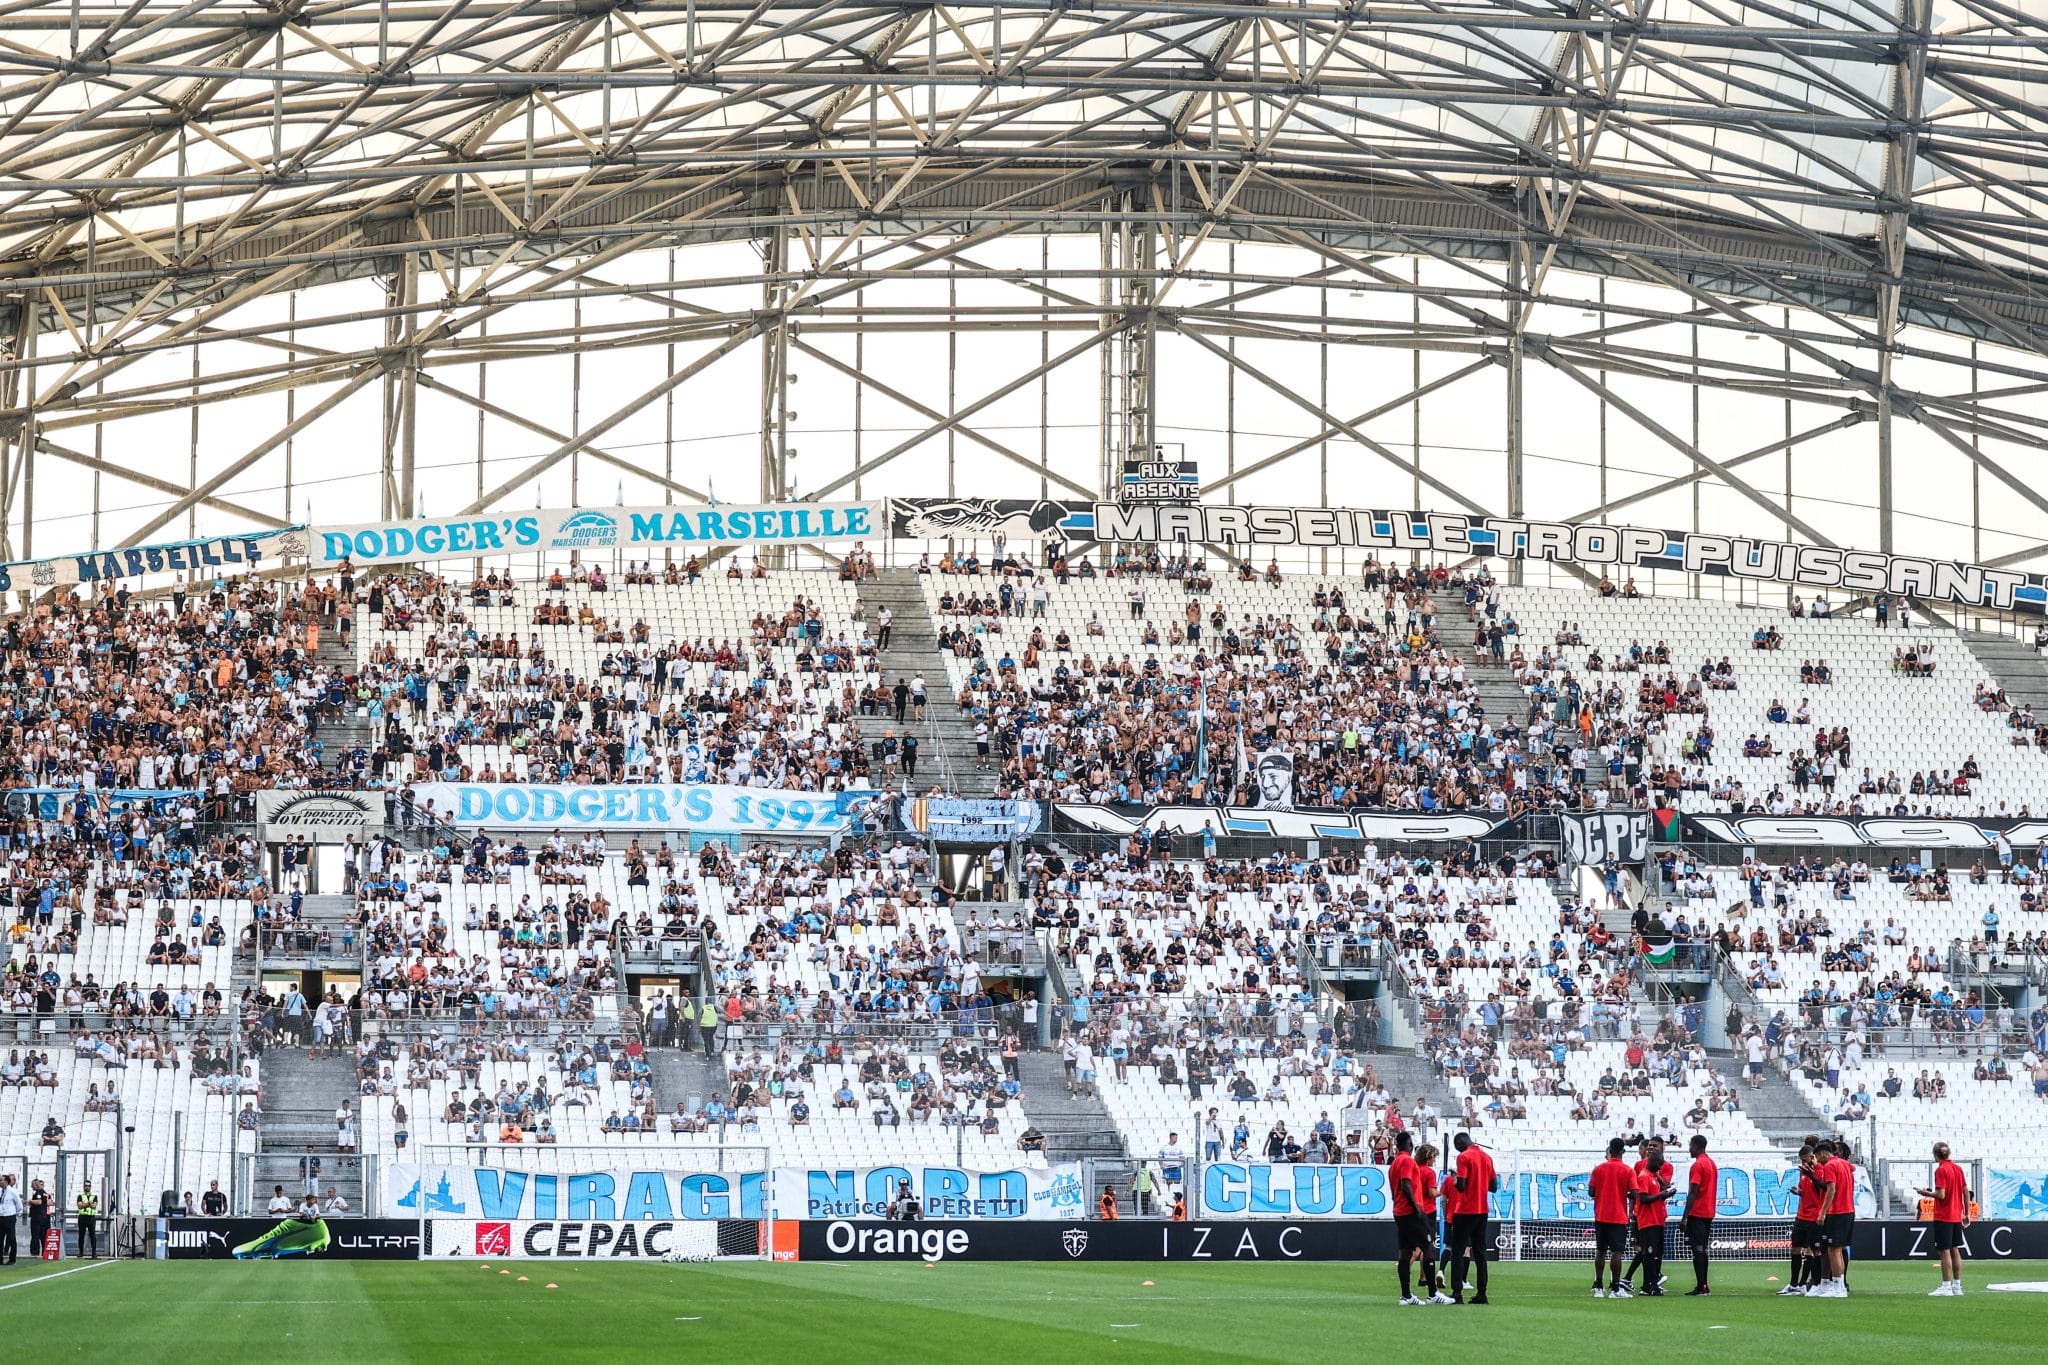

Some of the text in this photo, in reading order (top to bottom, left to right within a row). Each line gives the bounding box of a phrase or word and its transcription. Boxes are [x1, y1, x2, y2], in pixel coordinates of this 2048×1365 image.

[1140, 462, 1178, 479] AUX
[1124, 482, 1199, 499] ABSENTS
[323, 507, 870, 561] DODGER'S MARSEILLE
[551, 538, 617, 547] MARSEILLE 1992
[572, 527, 617, 538] DODGER'S
[76, 539, 262, 583] MARSEILLE
[1094, 502, 1471, 554] MARSEILLE
[1484, 517, 1667, 566] TROP
[1683, 532, 2029, 610] PUISSANT
[457, 786, 847, 832] DODGER'S 1992
[960, 816, 983, 825] 1992
[474, 1166, 1028, 1220] VIRAGE NORD
[1204, 1163, 1387, 1215] CLUB
[808, 1197, 1024, 1216] Patrice PERETTI
[522, 1222, 675, 1257] CEPAC
[825, 1221, 970, 1263] Orange
[1162, 1227, 1303, 1257] IZAC
[1710, 1240, 1747, 1250] Orange
